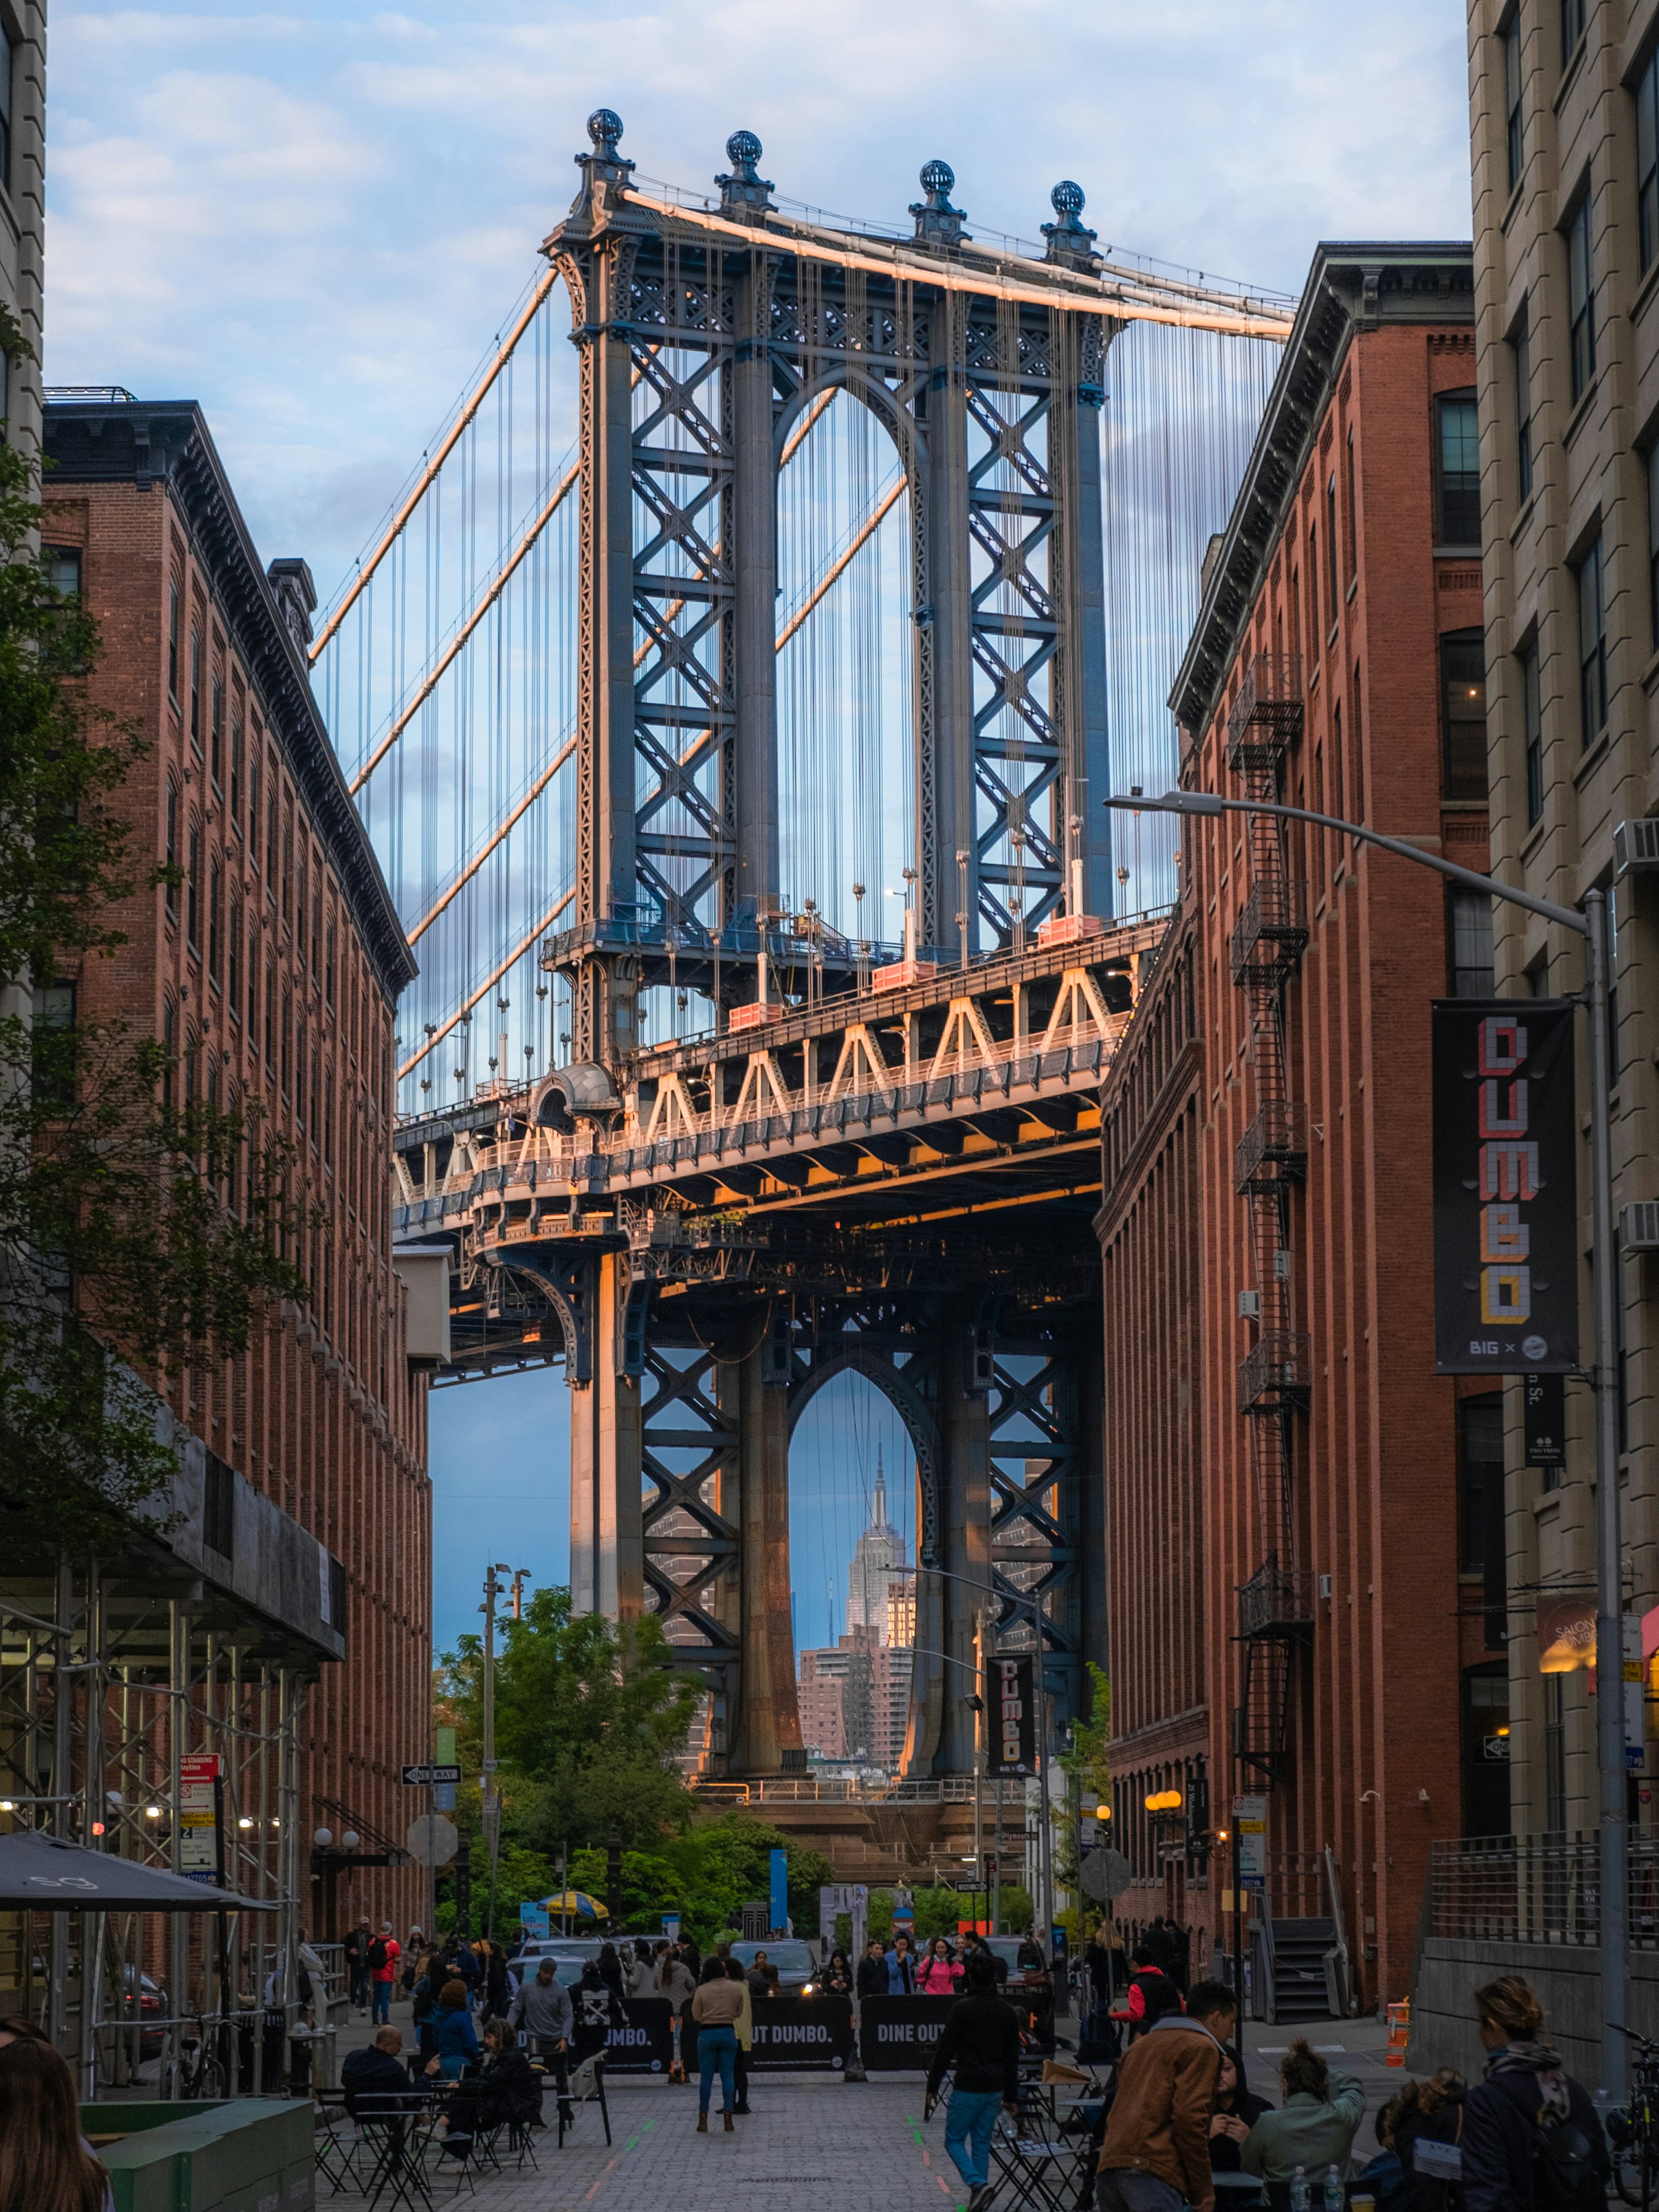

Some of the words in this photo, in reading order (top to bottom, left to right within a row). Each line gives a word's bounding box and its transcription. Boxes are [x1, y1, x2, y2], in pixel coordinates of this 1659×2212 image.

[1478, 1017, 1539, 1324] DUMBO
[1470, 1341, 1498, 1354] BIG
[1529, 1388, 1543, 1405] St.
[1556, 1618, 1596, 1638] SALON
[1001, 1660, 1022, 1762] DUMBO
[1187, 1793, 1195, 1829] Washington
[183, 1827, 190, 1839] 2
[30, 1877, 99, 1889] sg
[1056, 1936, 1062, 1944] P
[603, 2028, 652, 2047] UMBO.
[751, 2025, 769, 2044] UT
[772, 2025, 833, 2043] DUMBO.
[878, 2024, 914, 2042] DINE
